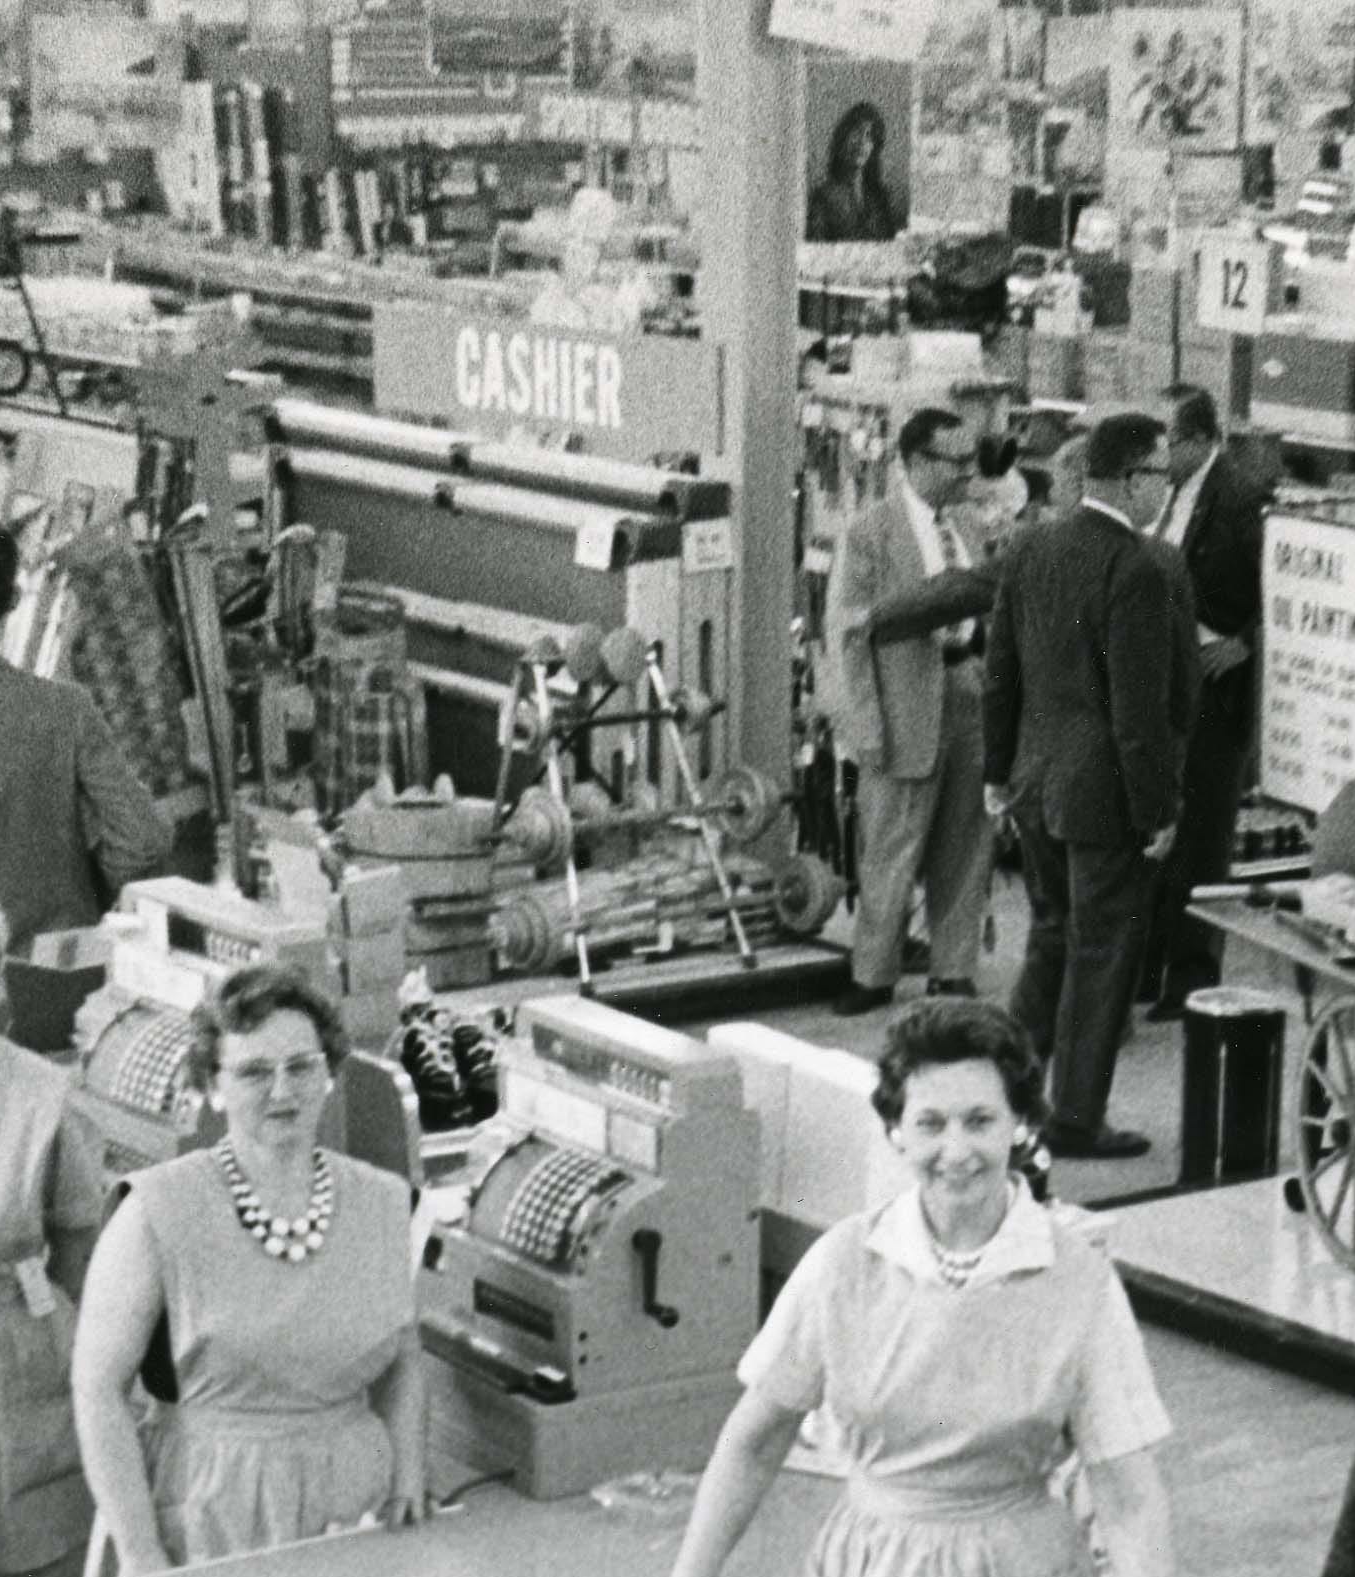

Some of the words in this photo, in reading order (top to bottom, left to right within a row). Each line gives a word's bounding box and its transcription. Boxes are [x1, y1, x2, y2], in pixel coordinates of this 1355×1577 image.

[1223, 258, 1248, 309] 12
[456, 325, 622, 429] CASHIER
[1273, 540, 1345, 585] ORIGINAL
[1272, 595, 1294, 632] OIL
